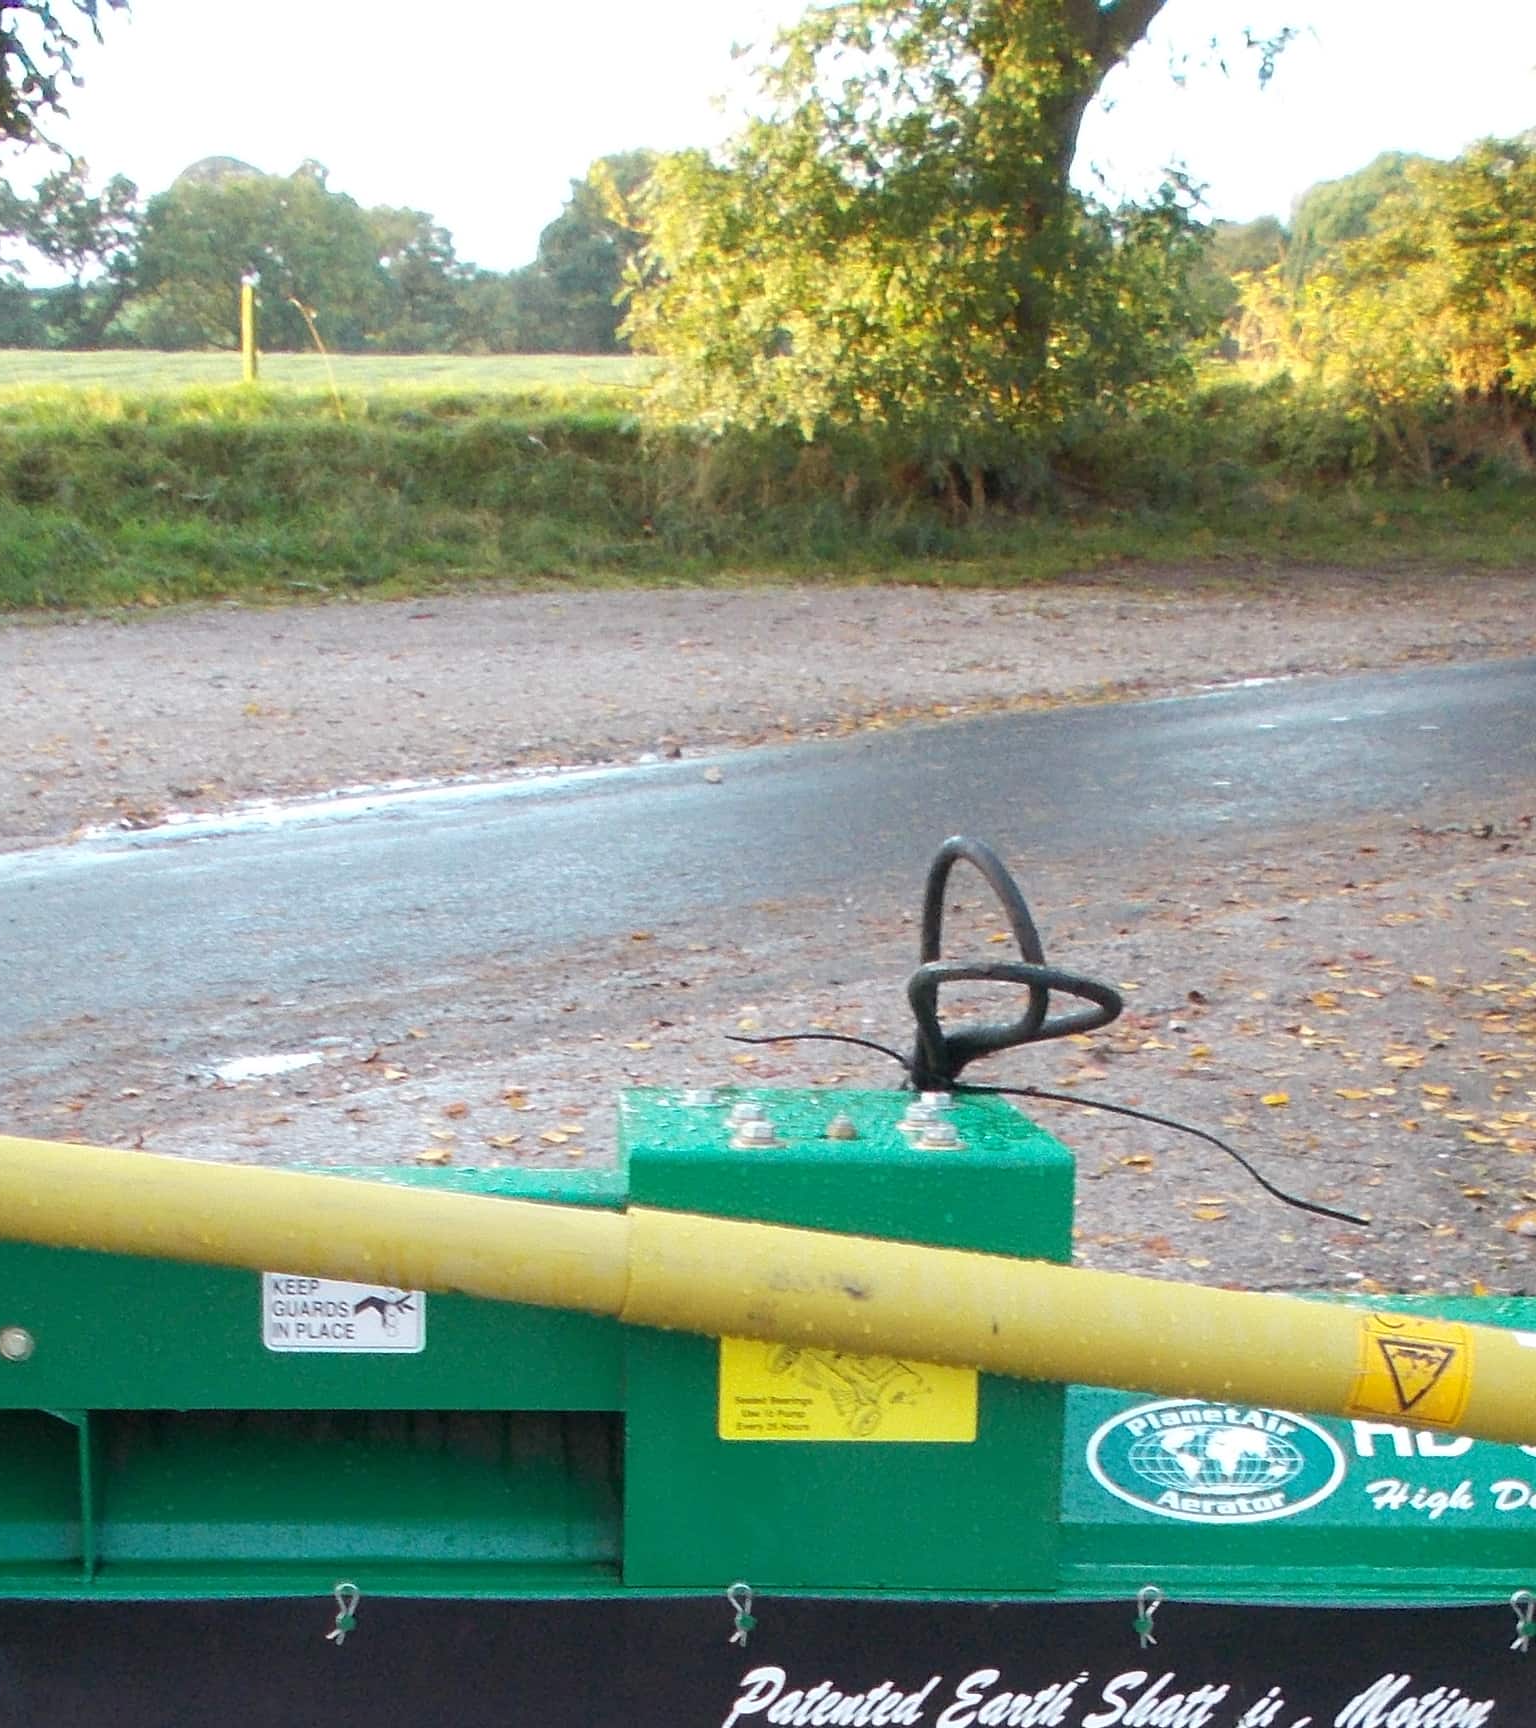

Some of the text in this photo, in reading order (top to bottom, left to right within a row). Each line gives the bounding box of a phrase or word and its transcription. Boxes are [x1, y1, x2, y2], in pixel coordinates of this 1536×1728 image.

[272, 1279, 320, 1296] KEEP
[272, 1300, 350, 1318] GUARDS
[272, 1322, 356, 1340] IN PLACE
[1124, 1407, 1297, 1437] PlanetAir
[1155, 1490, 1286, 1514] Aerator
[1365, 1479, 1474, 1520] High
